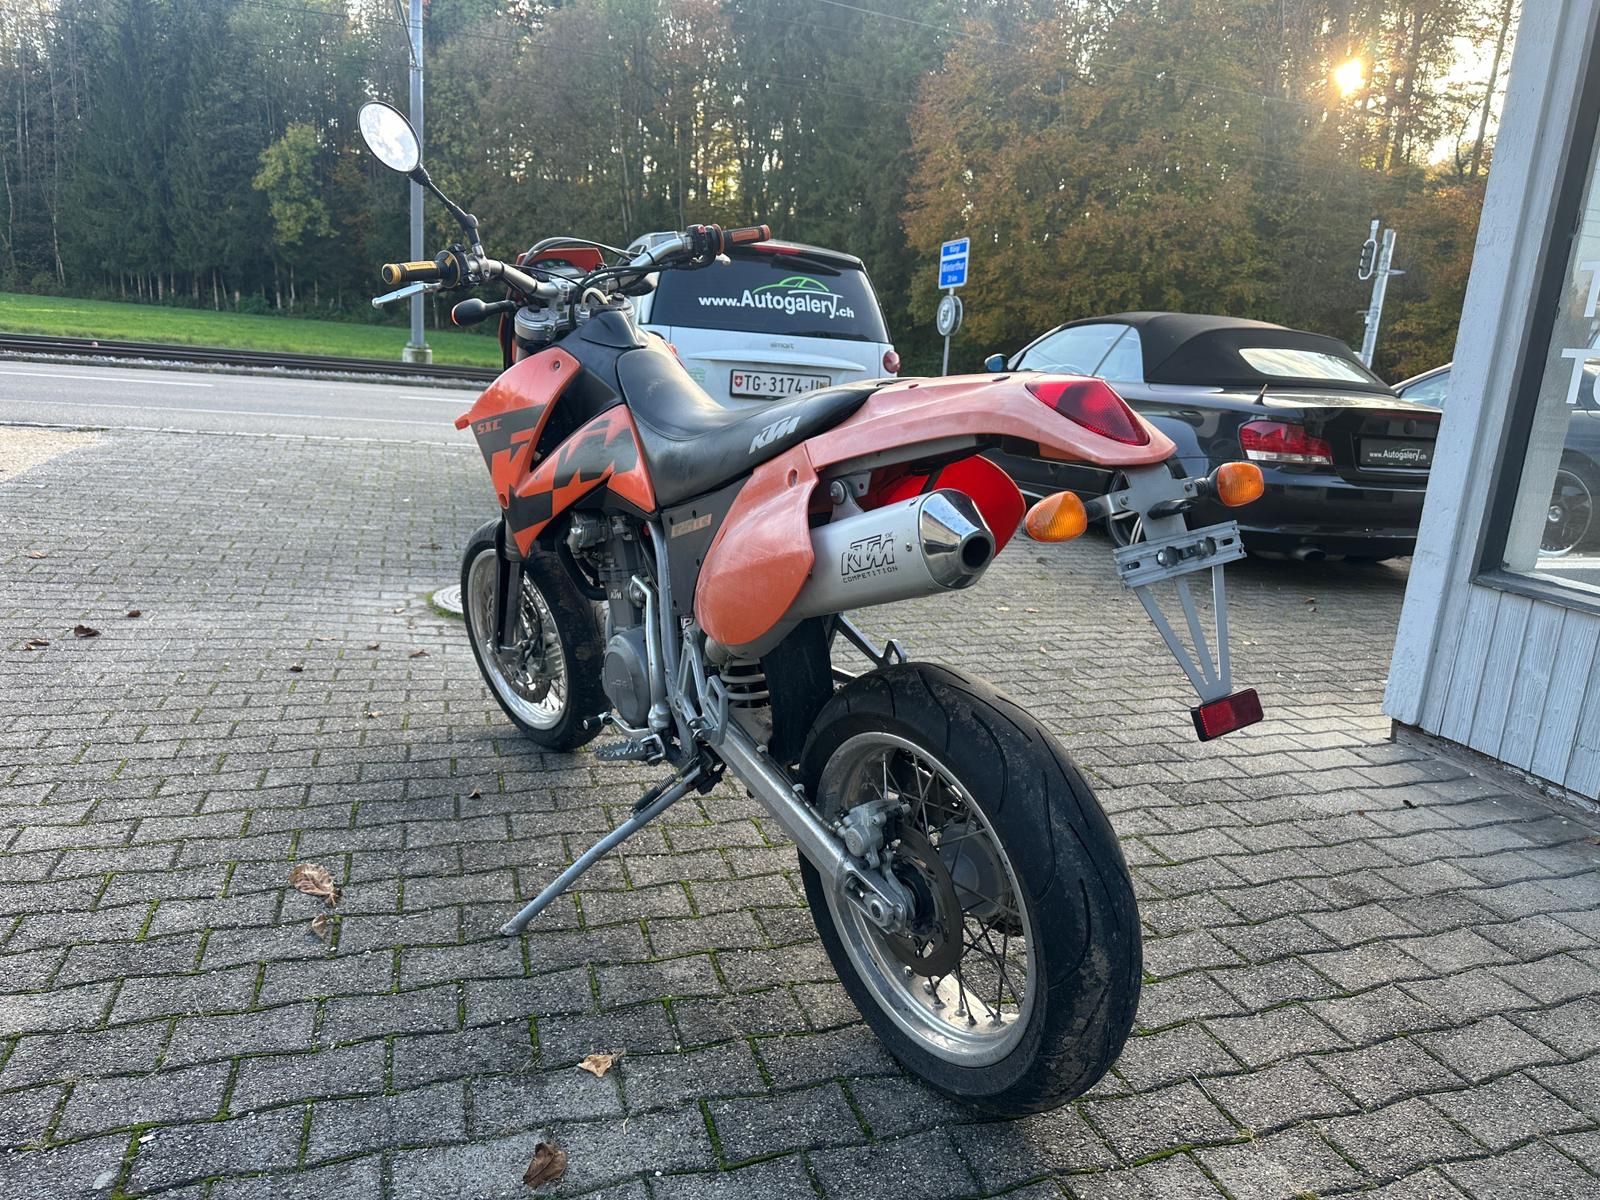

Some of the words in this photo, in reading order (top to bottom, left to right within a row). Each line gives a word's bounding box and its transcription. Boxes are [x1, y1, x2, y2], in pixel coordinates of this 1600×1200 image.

[698, 289, 855, 319] www.Autogalery.ch
[749, 415, 801, 454] KTM
[841, 534, 895, 576] KTM
[842, 566, 898, 583] COMPETITION
